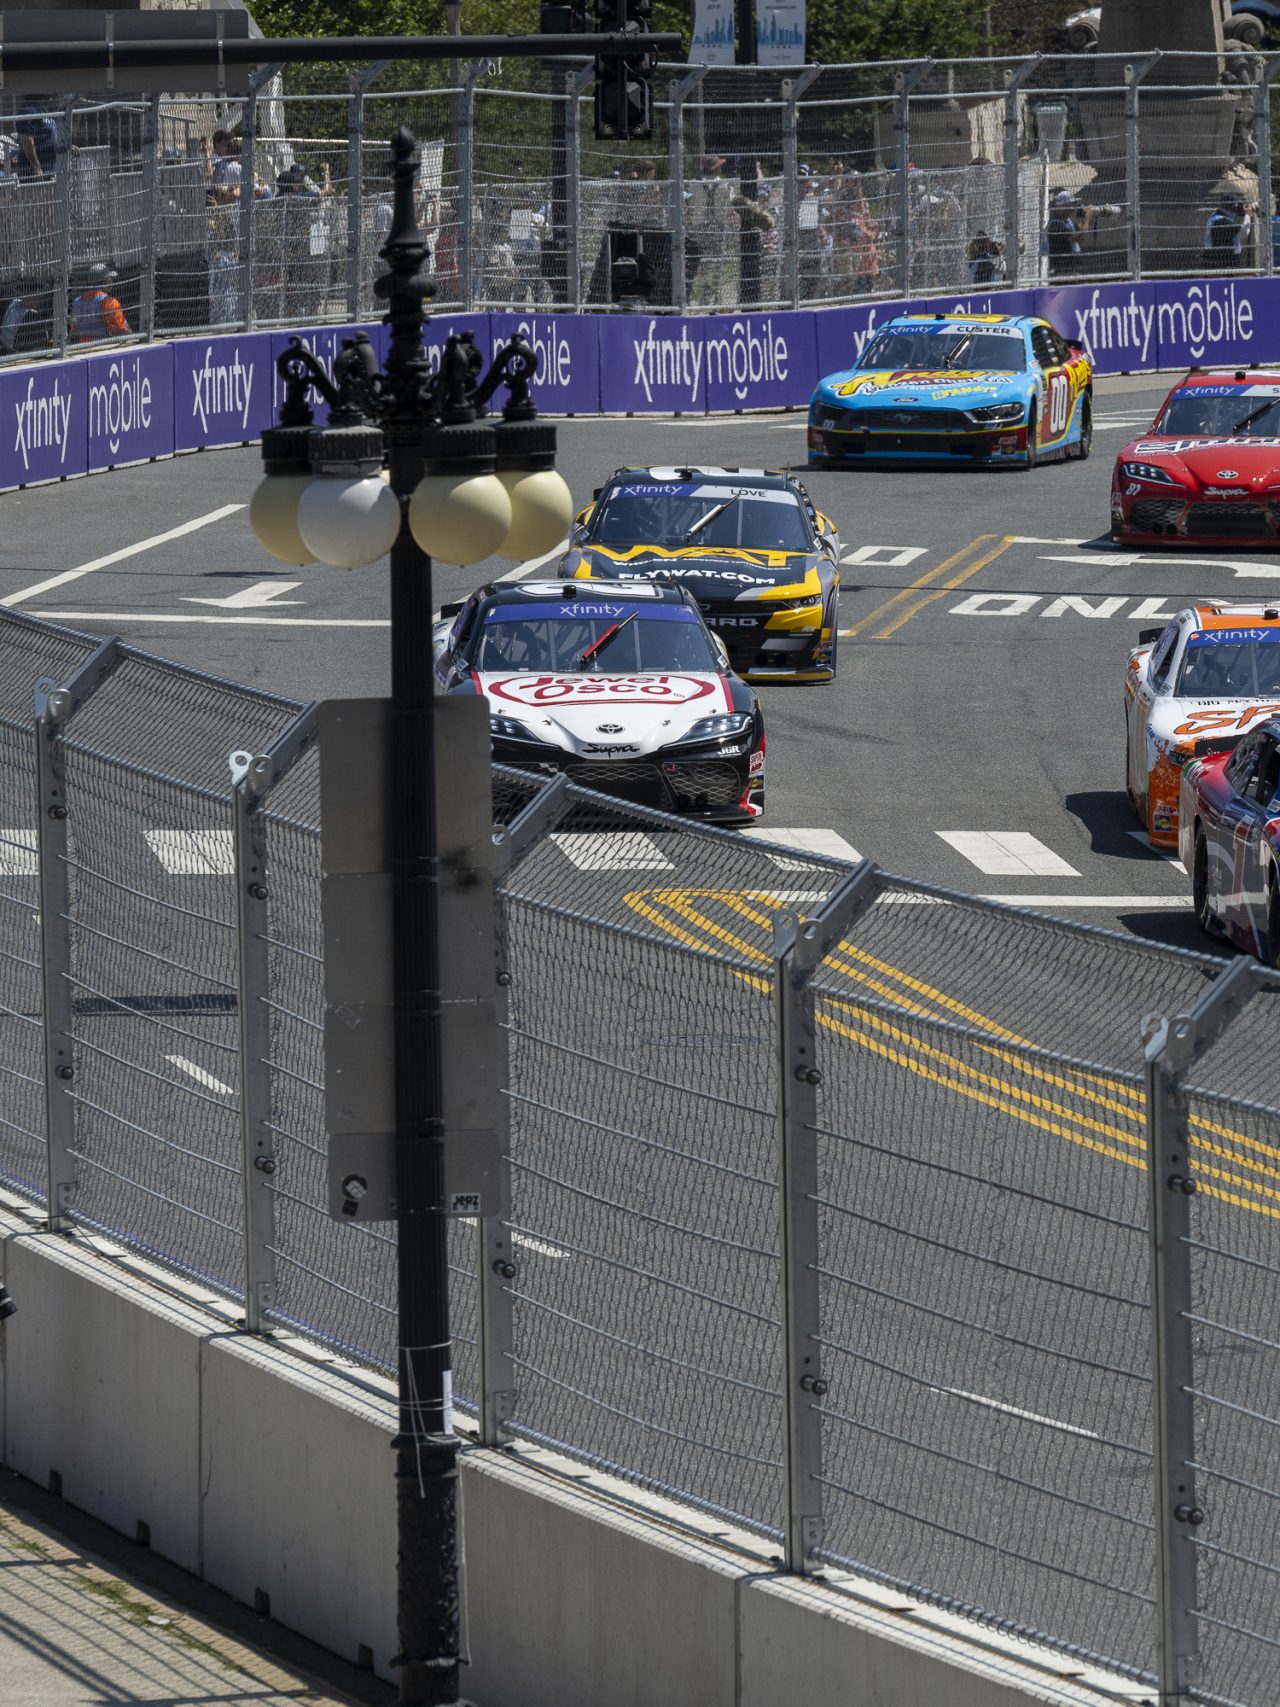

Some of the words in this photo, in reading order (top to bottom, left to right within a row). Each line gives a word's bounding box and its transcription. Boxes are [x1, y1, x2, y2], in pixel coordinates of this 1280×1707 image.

[887, 324, 936, 336] xfinity
[956, 325, 1011, 335] CUSTER
[1075, 289, 1155, 366] xfinity
[634, 320, 703, 403] xfinity
[192, 346, 255, 434] xfinity
[1050, 374, 1068, 433] 00
[1186, 385, 1235, 397] xfinity
[15, 376, 72, 470] xfinity
[624, 484, 683, 497] xfinity
[730, 488, 767, 498] LOVE
[560, 603, 625, 618] xfinity
[1203, 628, 1271, 641] xfinity
